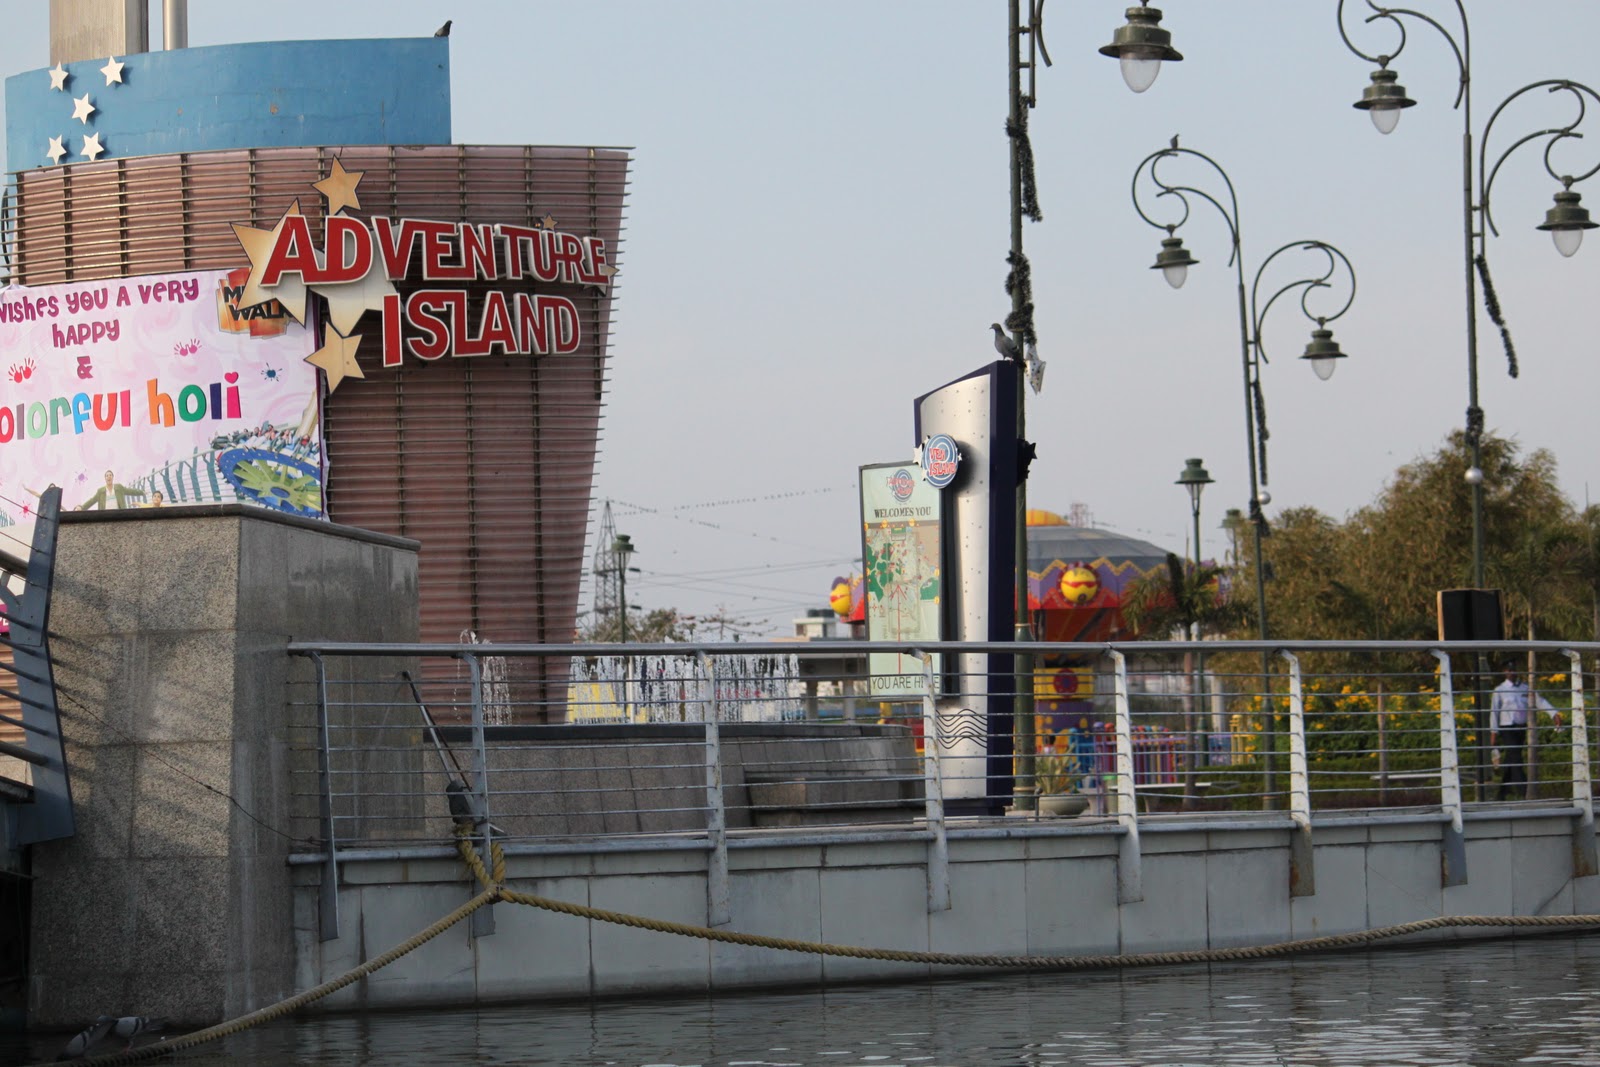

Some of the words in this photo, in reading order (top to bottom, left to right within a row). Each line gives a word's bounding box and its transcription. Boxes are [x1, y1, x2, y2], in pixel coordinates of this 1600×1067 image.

[259, 215, 610, 286] ADVENTURE
[116, 285, 131, 307] A
[382, 290, 581, 368] ISLAND
[76, 355, 93, 379] &
[147, 371, 242, 428] holi
[929, 462, 956, 476] ISLAND
[874, 507, 914, 518] WELCOMES
[915, 506, 931, 516] YOU
[872, 677, 891, 690] YOU
[892, 676, 912, 689] ARE
